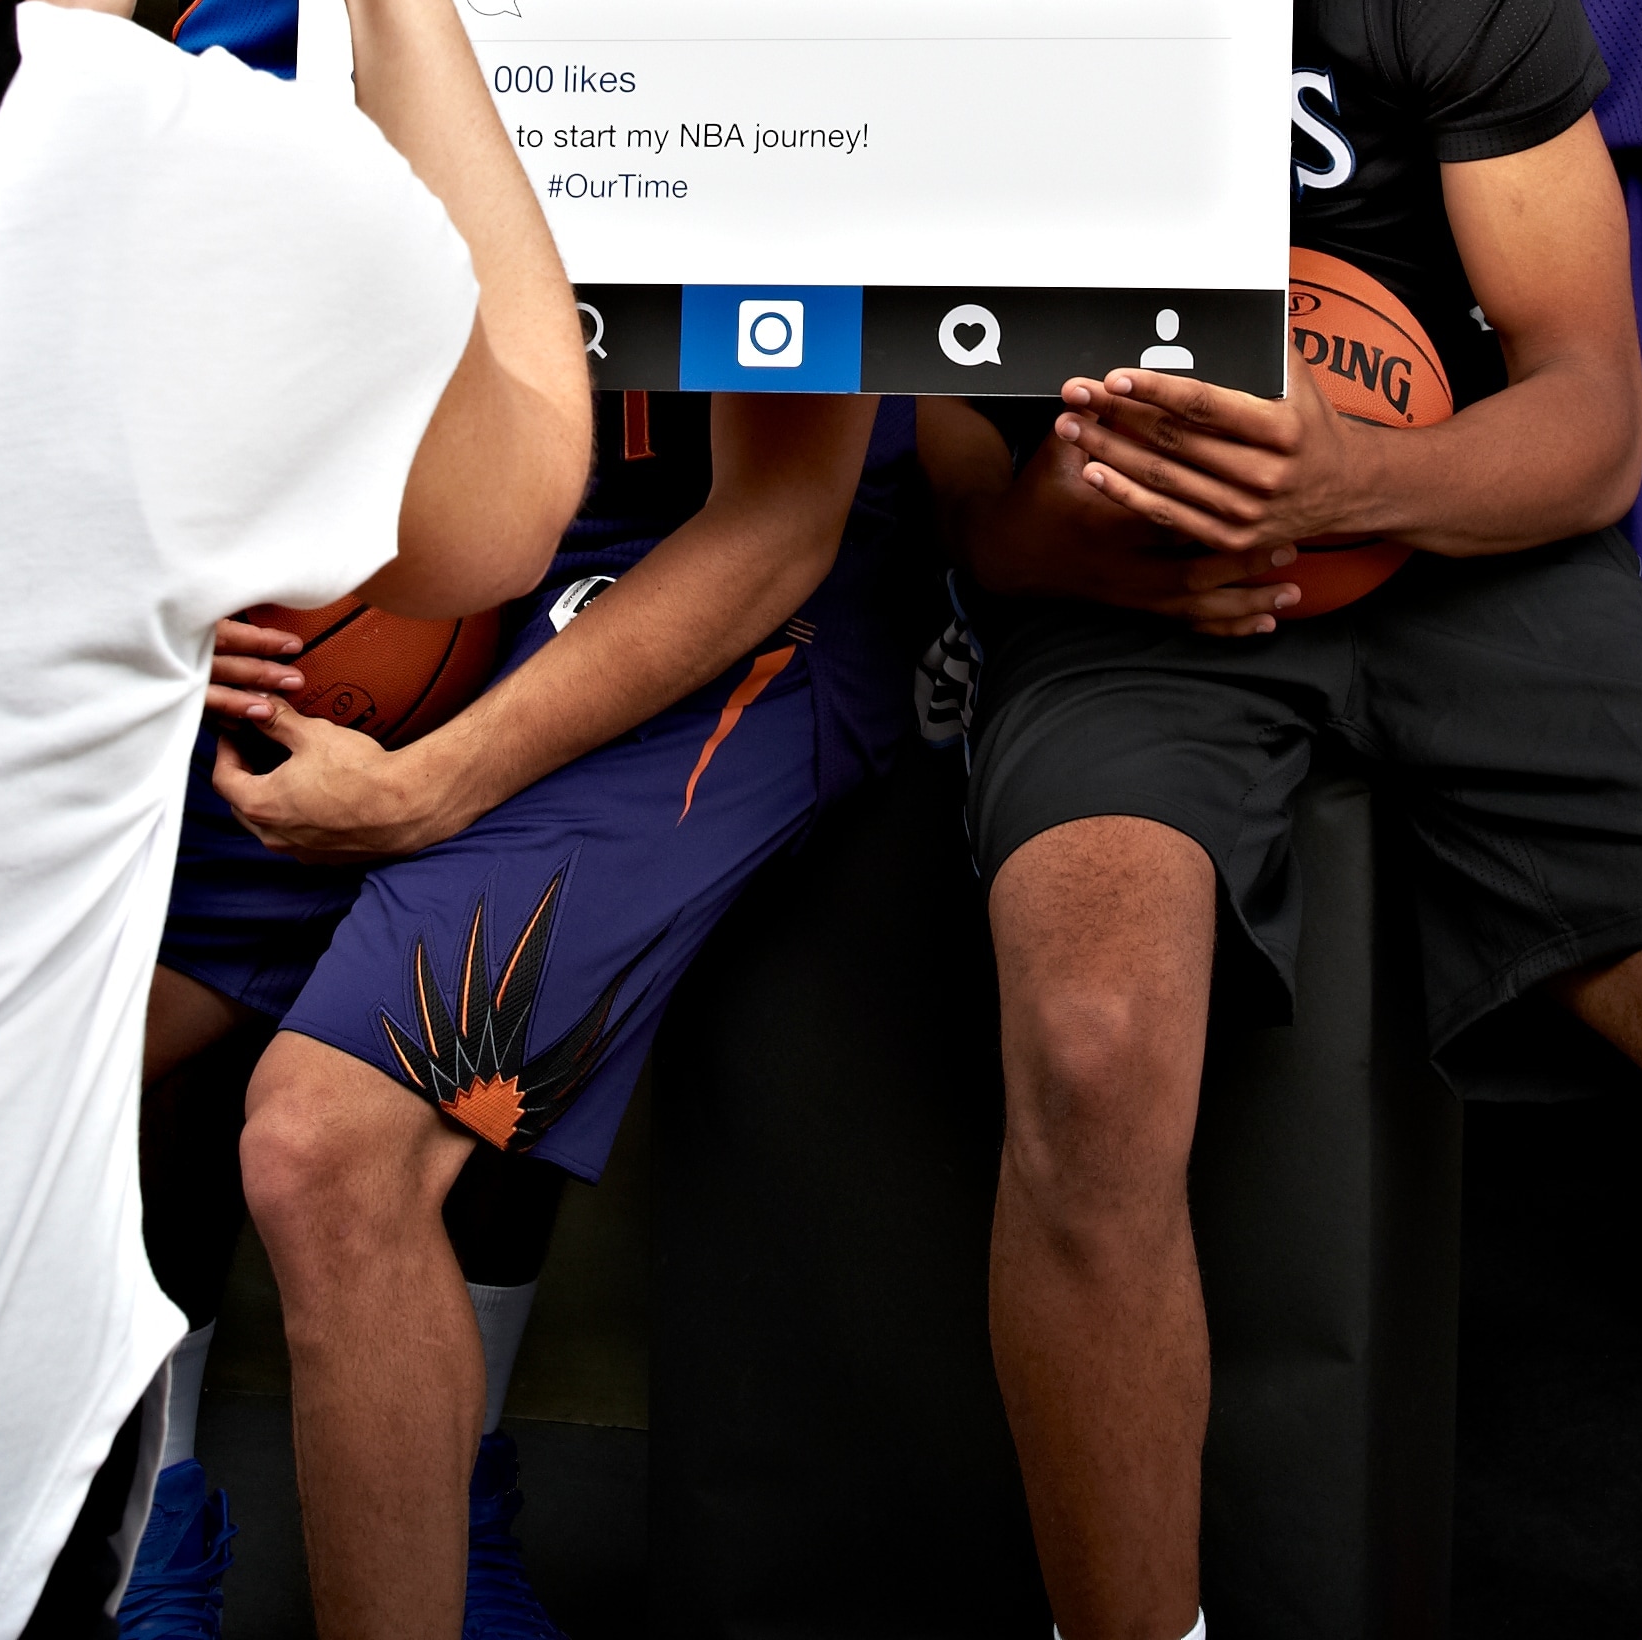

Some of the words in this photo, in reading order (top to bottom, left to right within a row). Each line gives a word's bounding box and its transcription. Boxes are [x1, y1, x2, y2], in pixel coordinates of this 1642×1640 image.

[493, 65, 554, 93] 000
[563, 65, 637, 93] likes
[516, 125, 544, 148] to
[553, 125, 617, 148] start
[627, 129, 669, 154] my
[680, 124, 745, 148] NBA
[753, 124, 869, 154] journey!
[1292, 66, 1356, 202] S
[547, 173, 688, 199] #OurTime
[1292, 327, 1412, 415] DING
